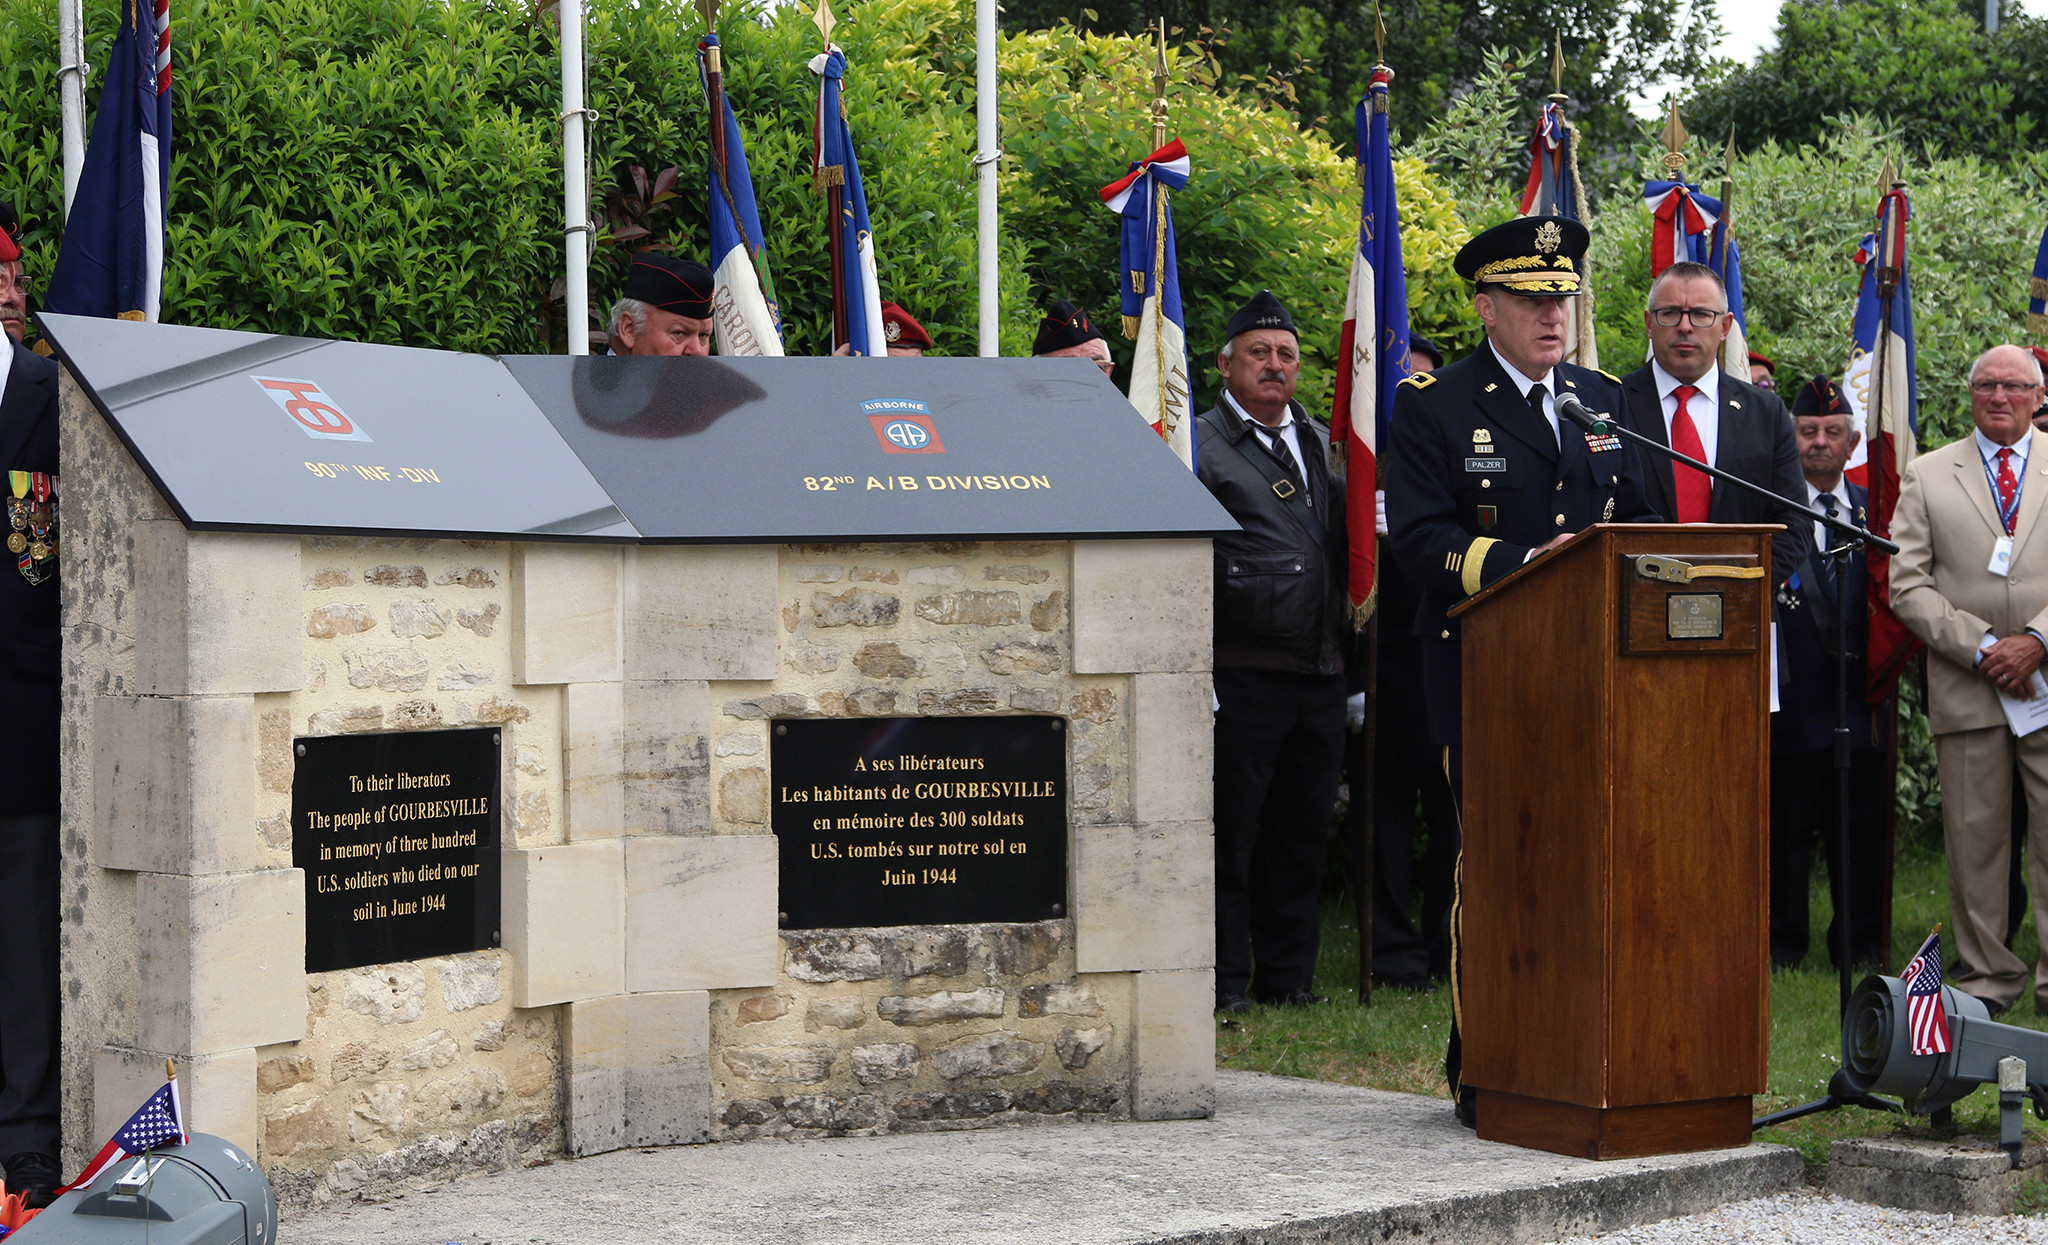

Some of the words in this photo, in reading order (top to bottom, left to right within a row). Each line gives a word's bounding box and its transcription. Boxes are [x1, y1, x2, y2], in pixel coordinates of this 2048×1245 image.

[865, 401, 924, 411] AIRBORNE
[887, 423, 928, 447] AA
[304, 461, 349, 479] 90TH
[1472, 461, 1501, 469] PALZER
[803, 475, 855, 491] 82ND
[926, 475, 1052, 490] DIVISION
[855, 757, 866, 771] A
[873, 760, 894, 771] ses
[900, 755, 984, 770] libérateurs
[349, 776, 363, 792] To
[367, 774, 394, 791] their
[398, 773, 450, 789] liberators
[782, 787, 808, 802] Les
[814, 785, 886, 801] habitants
[892, 784, 909, 799] de
[915, 782, 1054, 799] GOURBESVILLE
[308, 811, 330, 829] The
[334, 808, 371, 831] people
[375, 806, 386, 823] of
[390, 798, 488, 821] GOURBESVILLE
[814, 819, 830, 830] en
[837, 813, 904, 829] mémoire
[910, 812, 934, 827] des
[940, 811, 966, 827] 300
[972, 811, 1023, 826] soldats
[321, 844, 331, 860] in
[336, 843, 381, 859] memory
[386, 836, 397, 853] of
[400, 835, 428, 852] three
[432, 829, 476, 849] hundred
[811, 843, 842, 859] U.S.
[848, 841, 903, 857] tombés
[909, 845, 933, 856] sur
[939, 842, 978, 855] notre
[984, 839, 1004, 854] sol
[1010, 843, 1026, 853] en
[318, 874, 340, 893] U.S.
[345, 871, 388, 890] soldiers
[393, 867, 414, 883] who
[418, 863, 441, 881] died
[445, 867, 457, 879] on
[461, 864, 479, 877] our
[882, 870, 915, 885] Juin
[923, 869, 956, 884] 1944
[354, 903, 372, 921] soil
[377, 902, 386, 918] in
[391, 899, 417, 916] June
[422, 894, 445, 912] 1944
